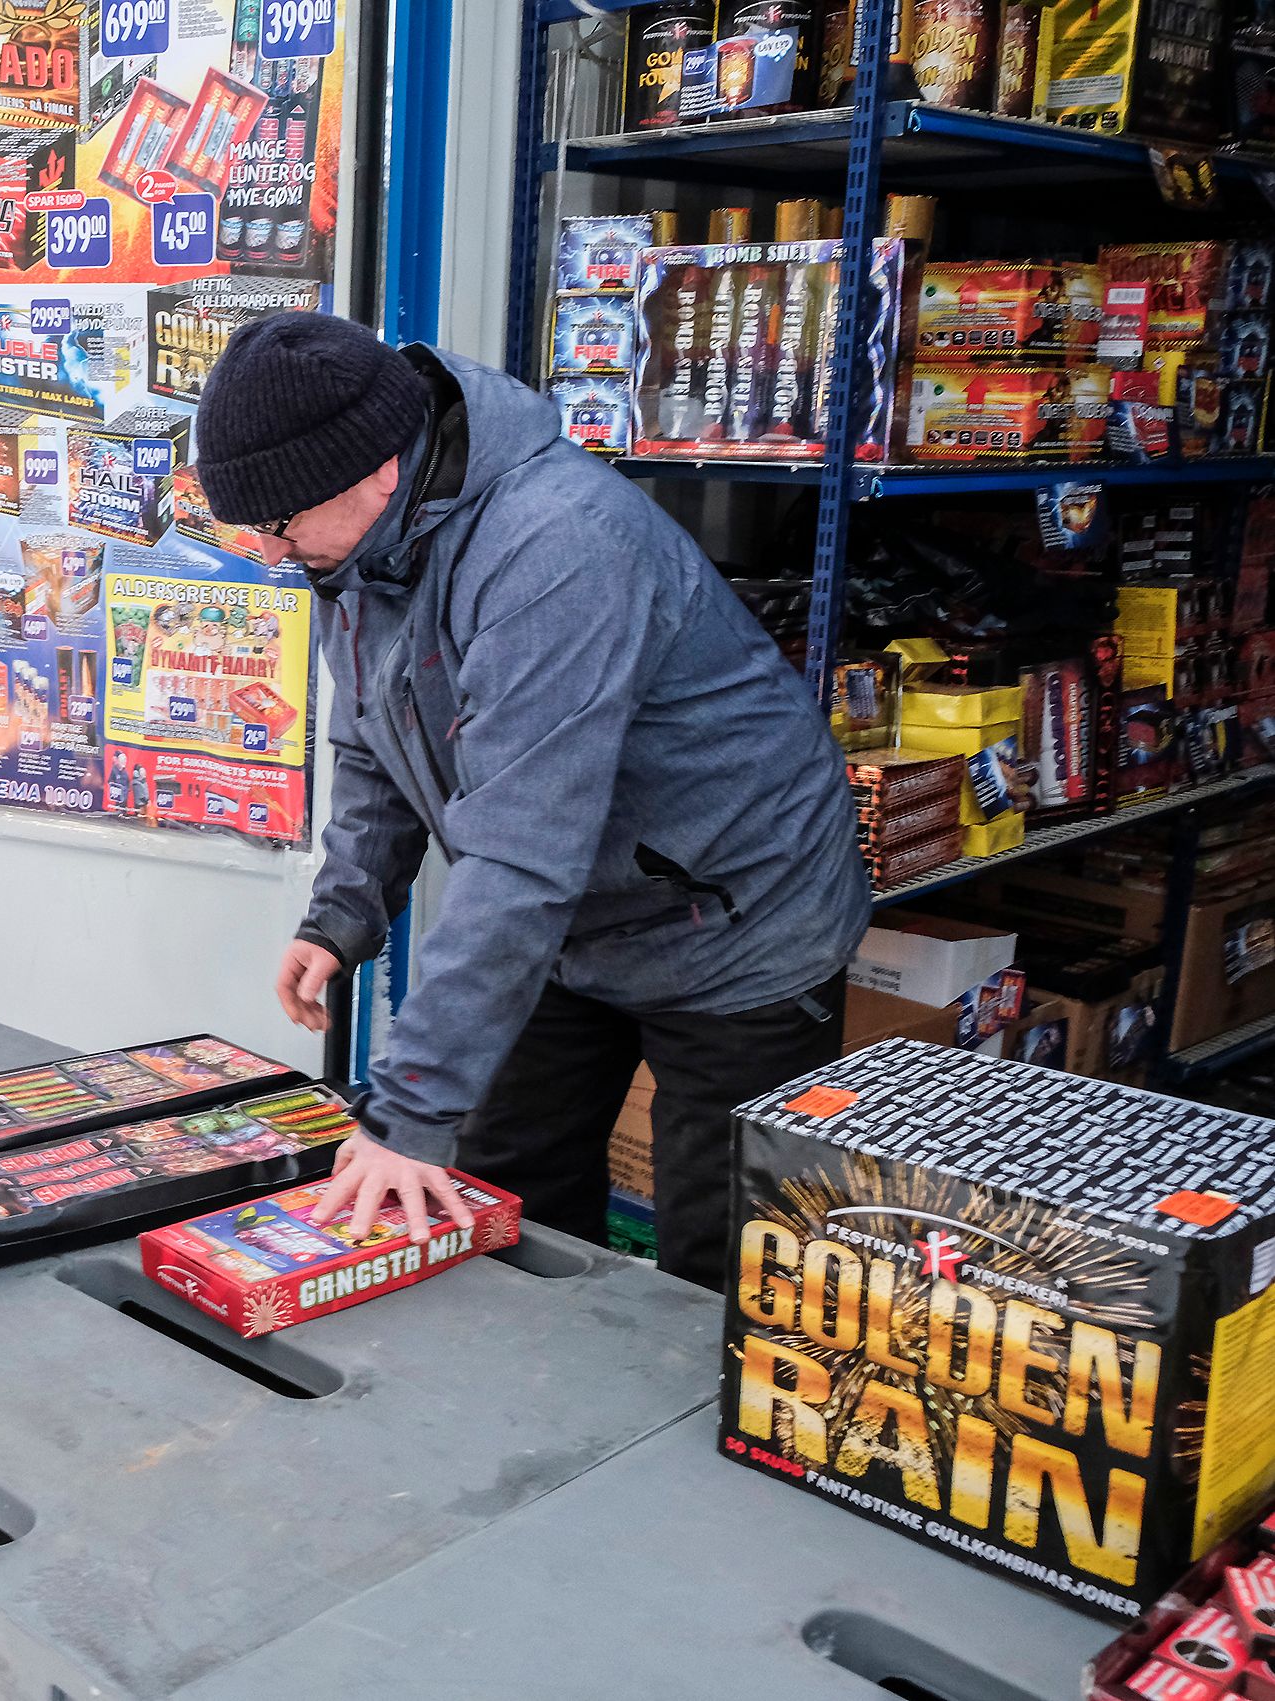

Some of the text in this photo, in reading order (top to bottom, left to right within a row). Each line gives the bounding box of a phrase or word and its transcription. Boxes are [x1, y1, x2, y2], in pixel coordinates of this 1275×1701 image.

[43, 103, 74, 117] FINALE
[229, 140, 287, 160] MANGE
[229, 162, 316, 185] LUNTER OG
[141, 176, 155, 198] 2
[229, 184, 303, 208] MYE GØY!
[28, 195, 54, 208] SPAR
[712, 246, 764, 263] BOMB
[766, 244, 820, 262] SHELL
[586, 264, 631, 280] FIRE
[192, 278, 232, 293] HEFTIG
[154, 311, 237, 354] GOLDE
[573, 344, 619, 359] FIRE
[41, 391, 63, 403] MAX
[64, 394, 96, 408] LADET
[569, 425, 612, 439] FIRE
[79, 465, 143, 496] HAIL
[79, 488, 141, 514] STORM
[112, 577, 300, 613] ALDERSGRENSE 12 ÅR
[156, 755, 181, 766] FOR
[43, 785, 94, 810] 1000
[298, 1225, 475, 1311] GANGSTA MIX
[825, 1222, 1069, 1308] FESTIVAL FYRVERKERI
[739, 1219, 1162, 1459] GOLDEN
[737, 1334, 1147, 1588] RAIN
[725, 1436, 1142, 1618] 50 SKUDD FANTASTISKE GULLKOMBINASJONER
